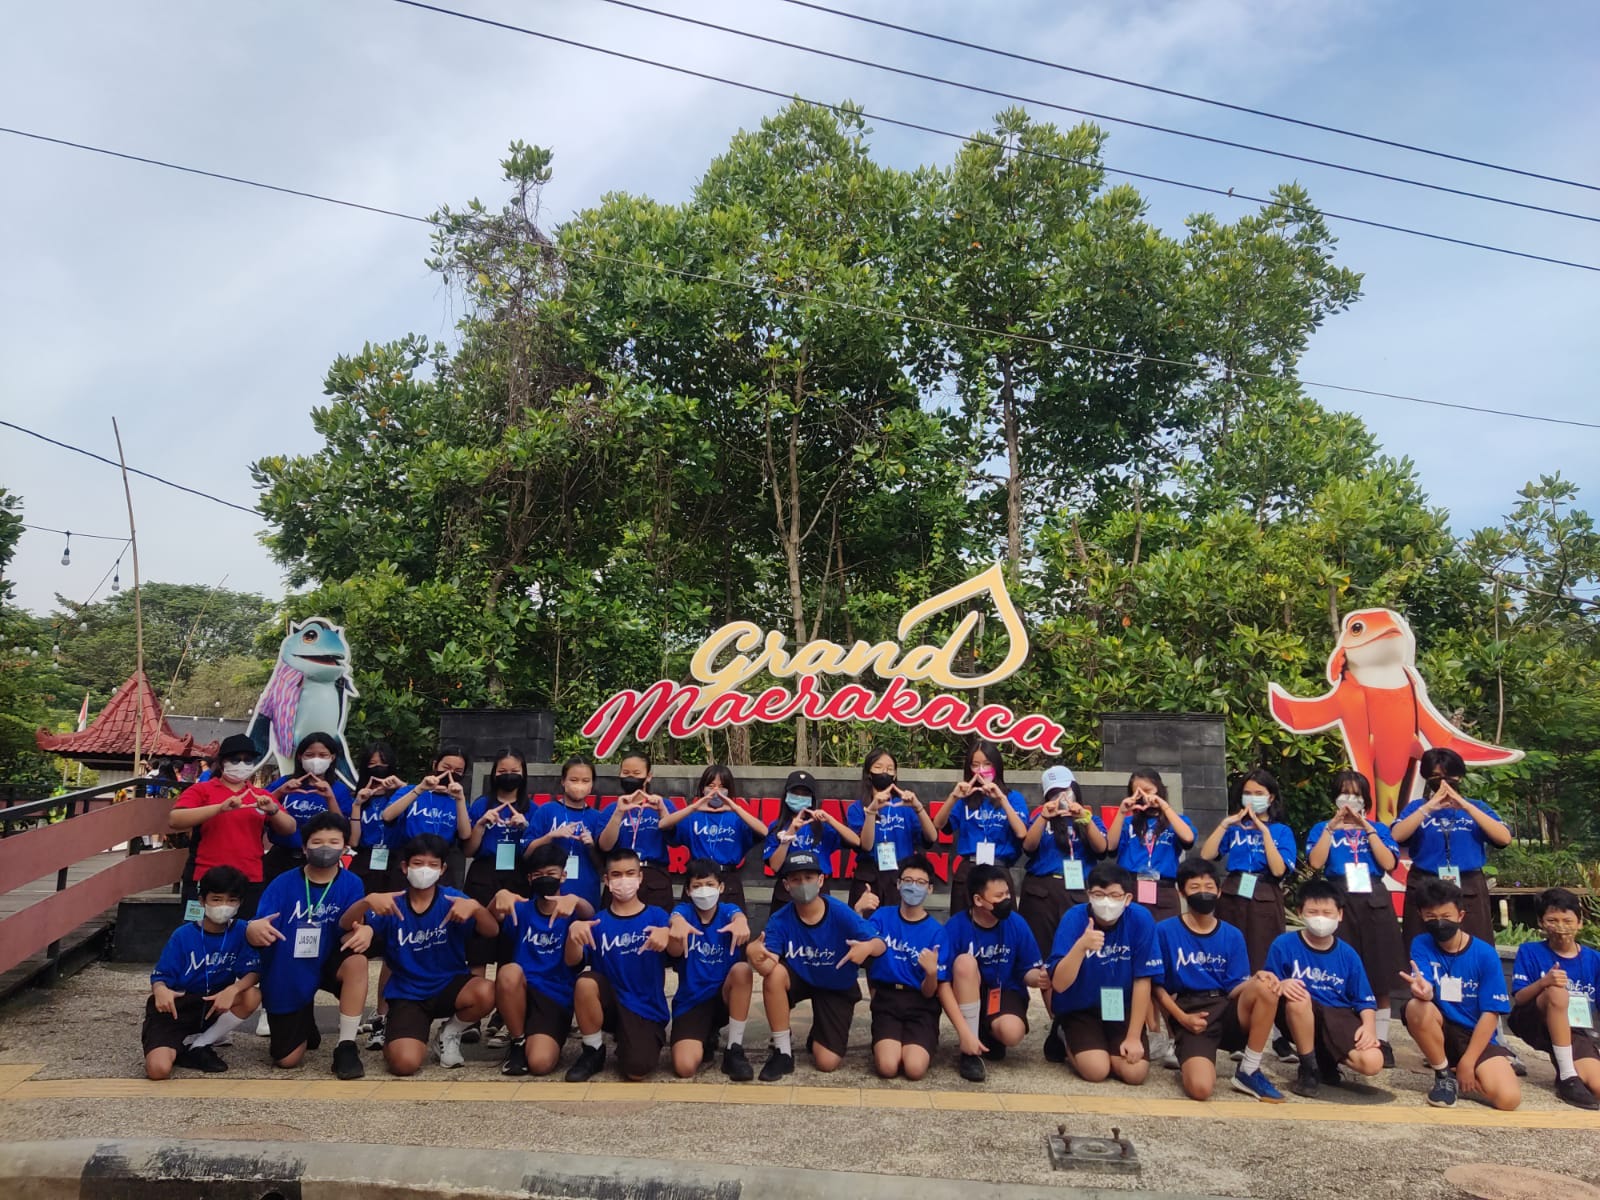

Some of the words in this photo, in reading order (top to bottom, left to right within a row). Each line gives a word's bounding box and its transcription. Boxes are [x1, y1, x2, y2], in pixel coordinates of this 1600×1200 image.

[690, 564, 1029, 711] Grand
[582, 675, 1067, 758] Maerakaca
[299, 935, 317, 945] JASON
